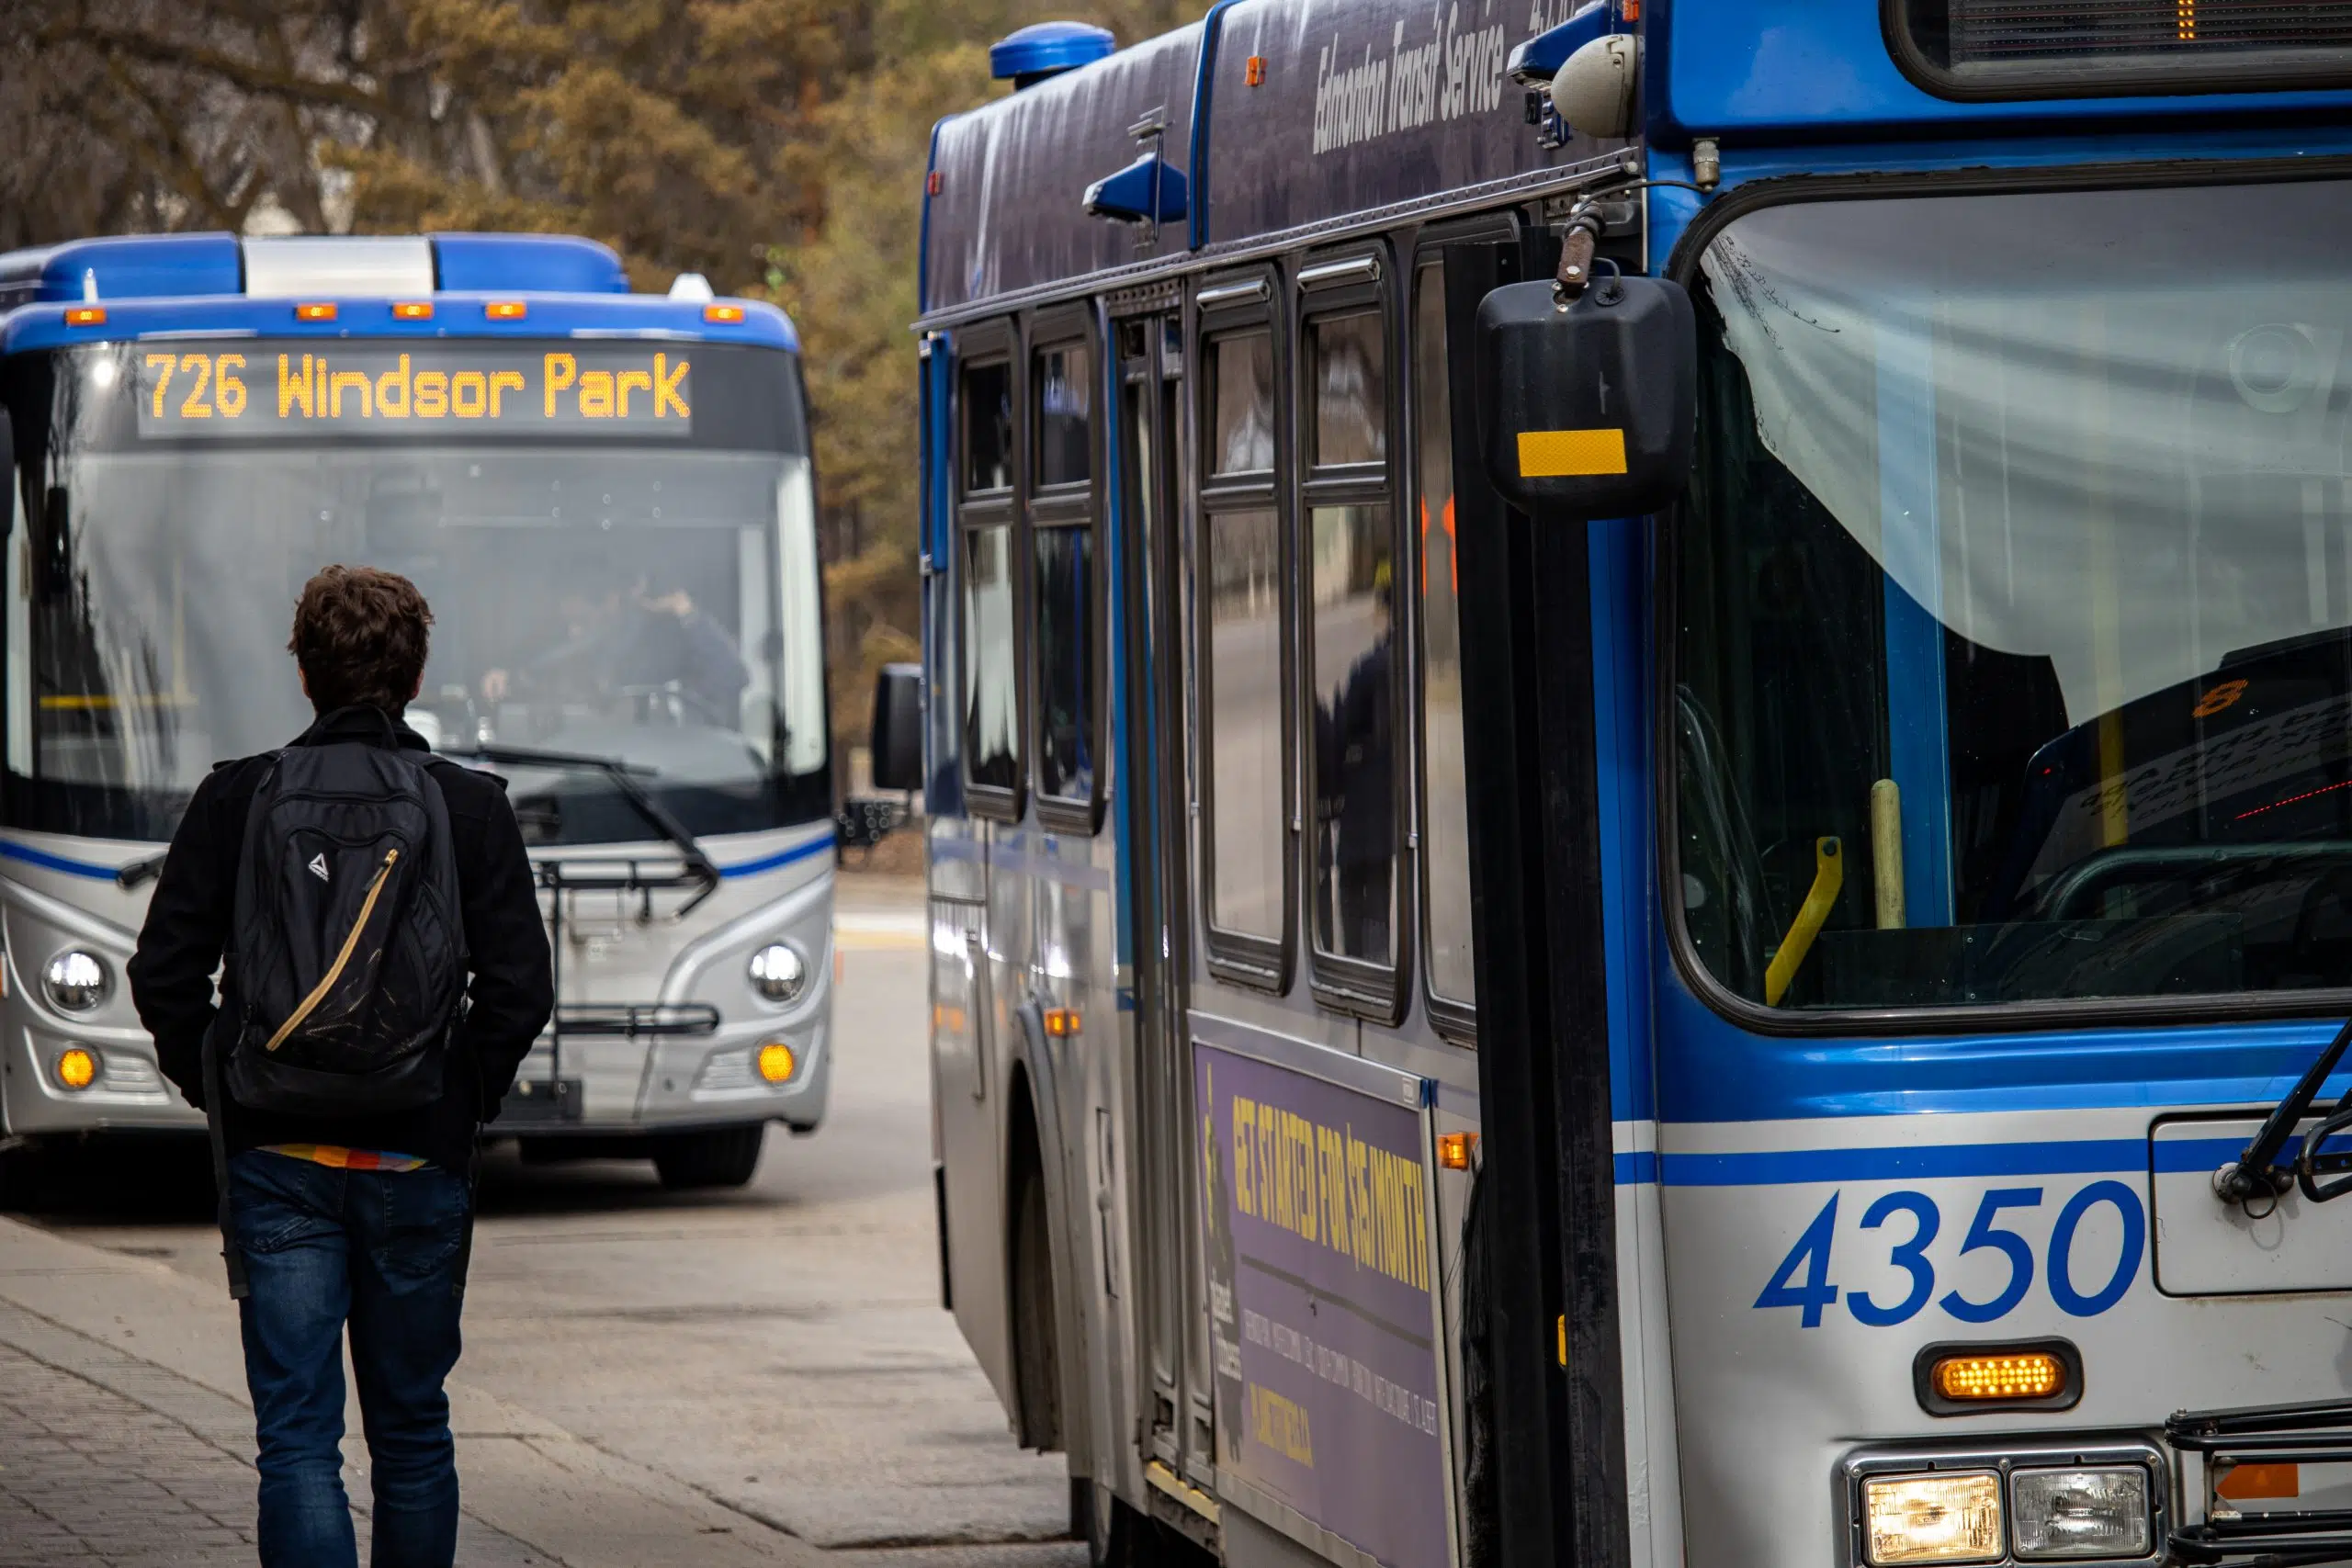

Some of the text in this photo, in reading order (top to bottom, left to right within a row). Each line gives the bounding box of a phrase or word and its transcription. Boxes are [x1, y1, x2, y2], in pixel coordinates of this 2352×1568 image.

[1313, 0, 1504, 154] Edmonton Transit Service
[146, 353, 690, 418] 726 Windsor Park
[1233, 1094, 1257, 1217] GET
[1258, 1101, 1317, 1242] STARTED
[1317, 1124, 1351, 1255] FOR
[1752, 1179, 2146, 1328] 4350
